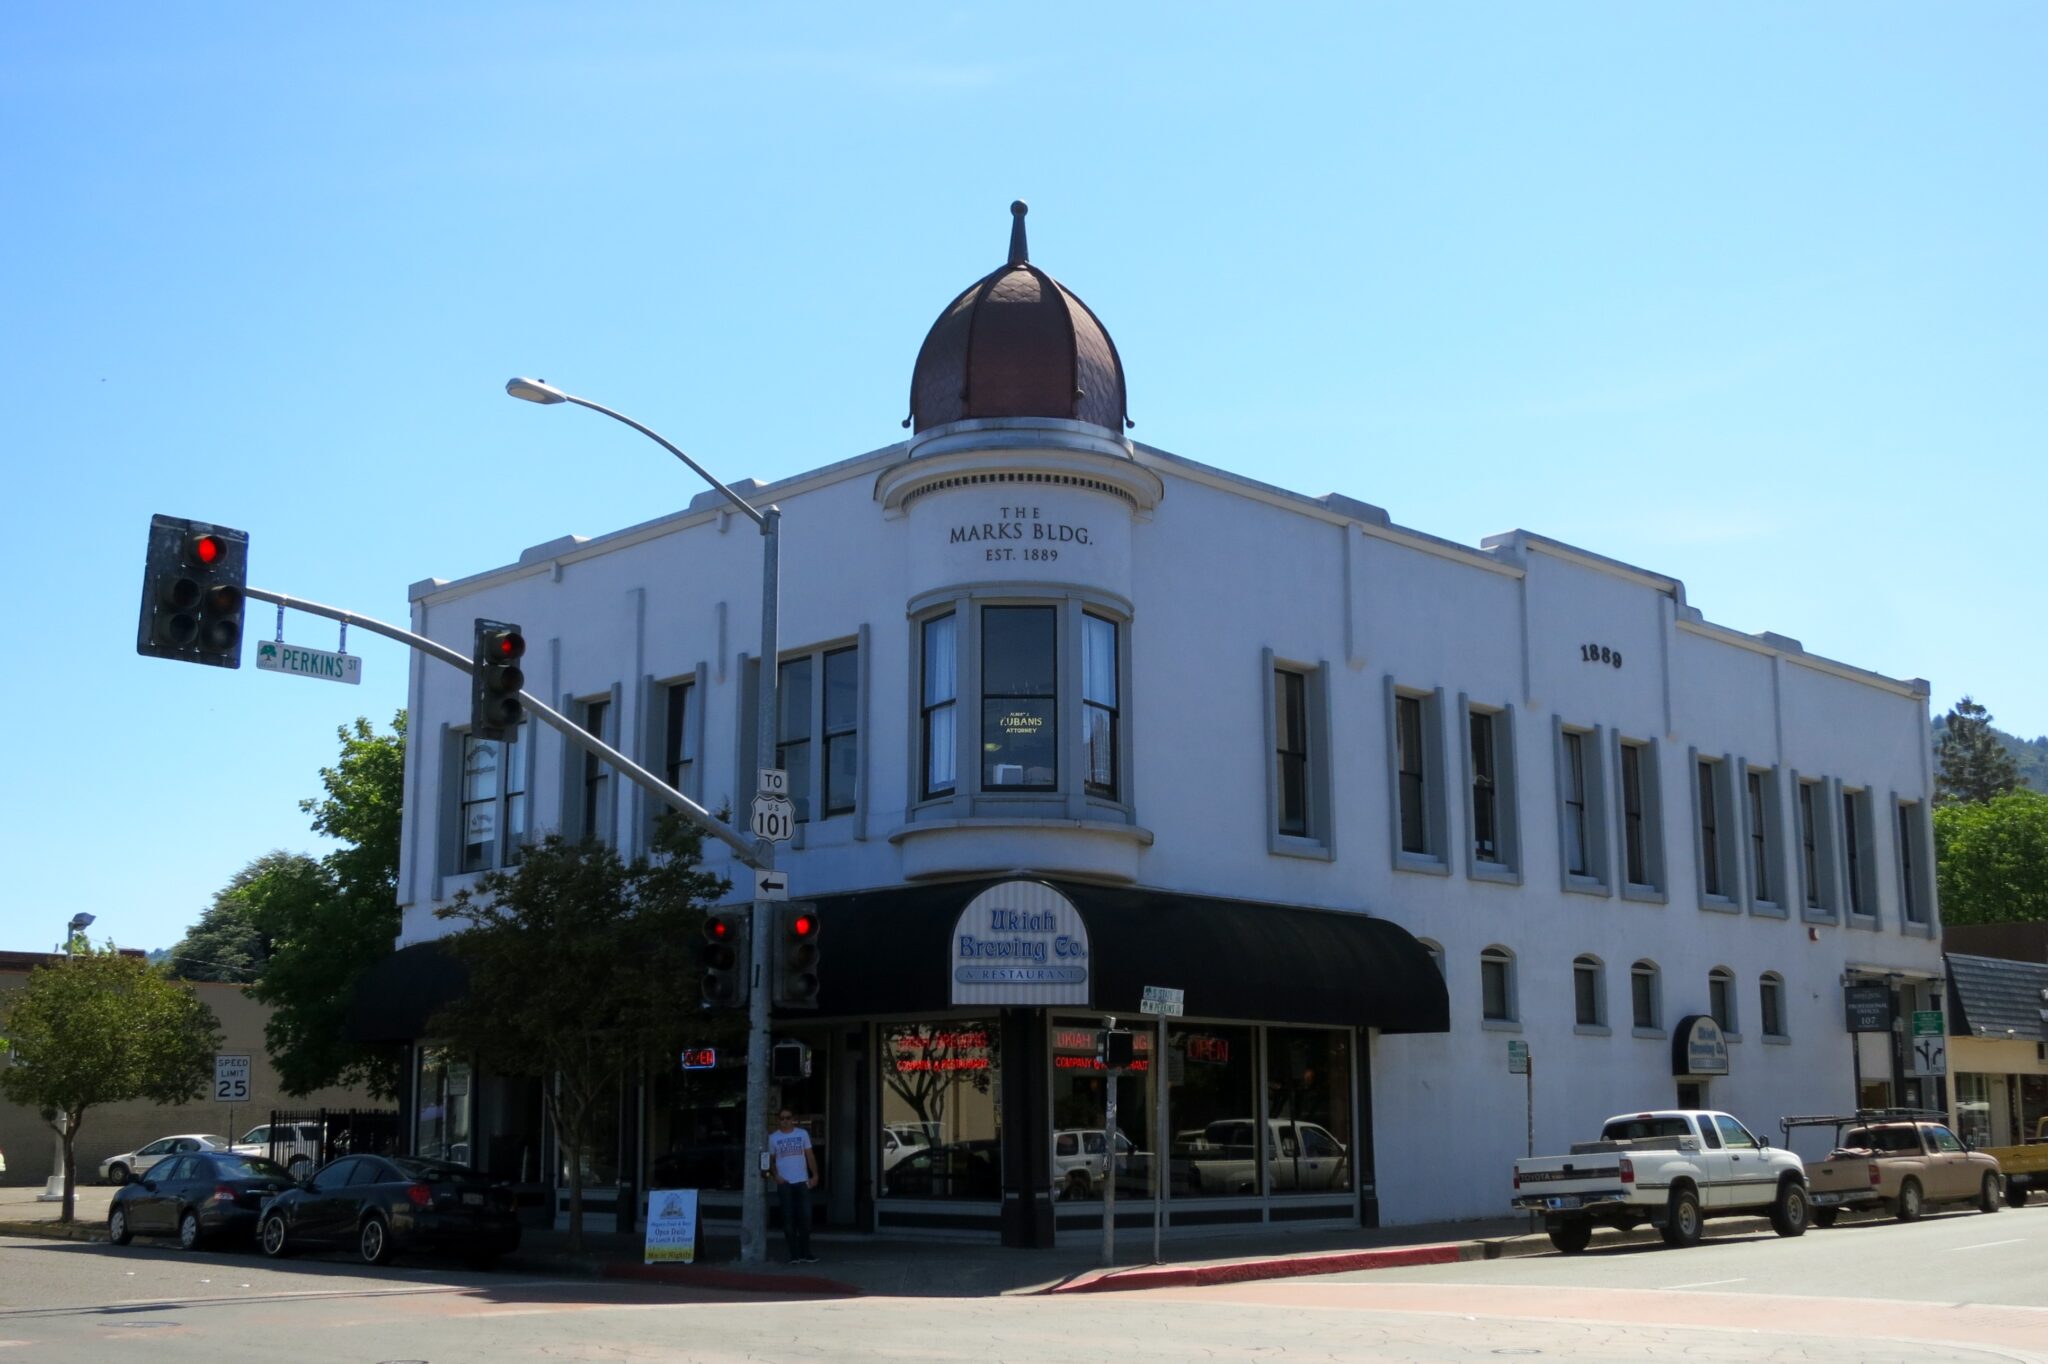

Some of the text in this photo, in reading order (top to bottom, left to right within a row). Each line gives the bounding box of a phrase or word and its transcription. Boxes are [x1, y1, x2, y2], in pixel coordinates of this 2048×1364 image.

[1000, 506, 1040, 519] THE
[950, 522, 1093, 545] MARKS BLDG.
[986, 548, 1058, 562] EST. 1889
[282, 648, 358, 678] PERKINS ST
[1580, 643, 1622, 669] 1889
[765, 774, 782, 788] TO
[768, 803, 780, 812] US
[759, 812, 787, 837] 101
[991, 909, 1057, 932] Ukiah
[960, 935, 1088, 963] Brewing Co.
[982, 969, 1074, 980] RESTAURANT
[1861, 1016, 1876, 1025] 107
[1056, 1032, 1092, 1048] UKIAH
[1186, 1039, 1229, 1063] OPEN
[218, 1059, 248, 1067] SPEED
[1055, 1056, 1091, 1069] COMPANY
[221, 1069, 244, 1077] LIMIT
[218, 1080, 247, 1097] 25
[1520, 1173, 1550, 1182] TOYOTA
